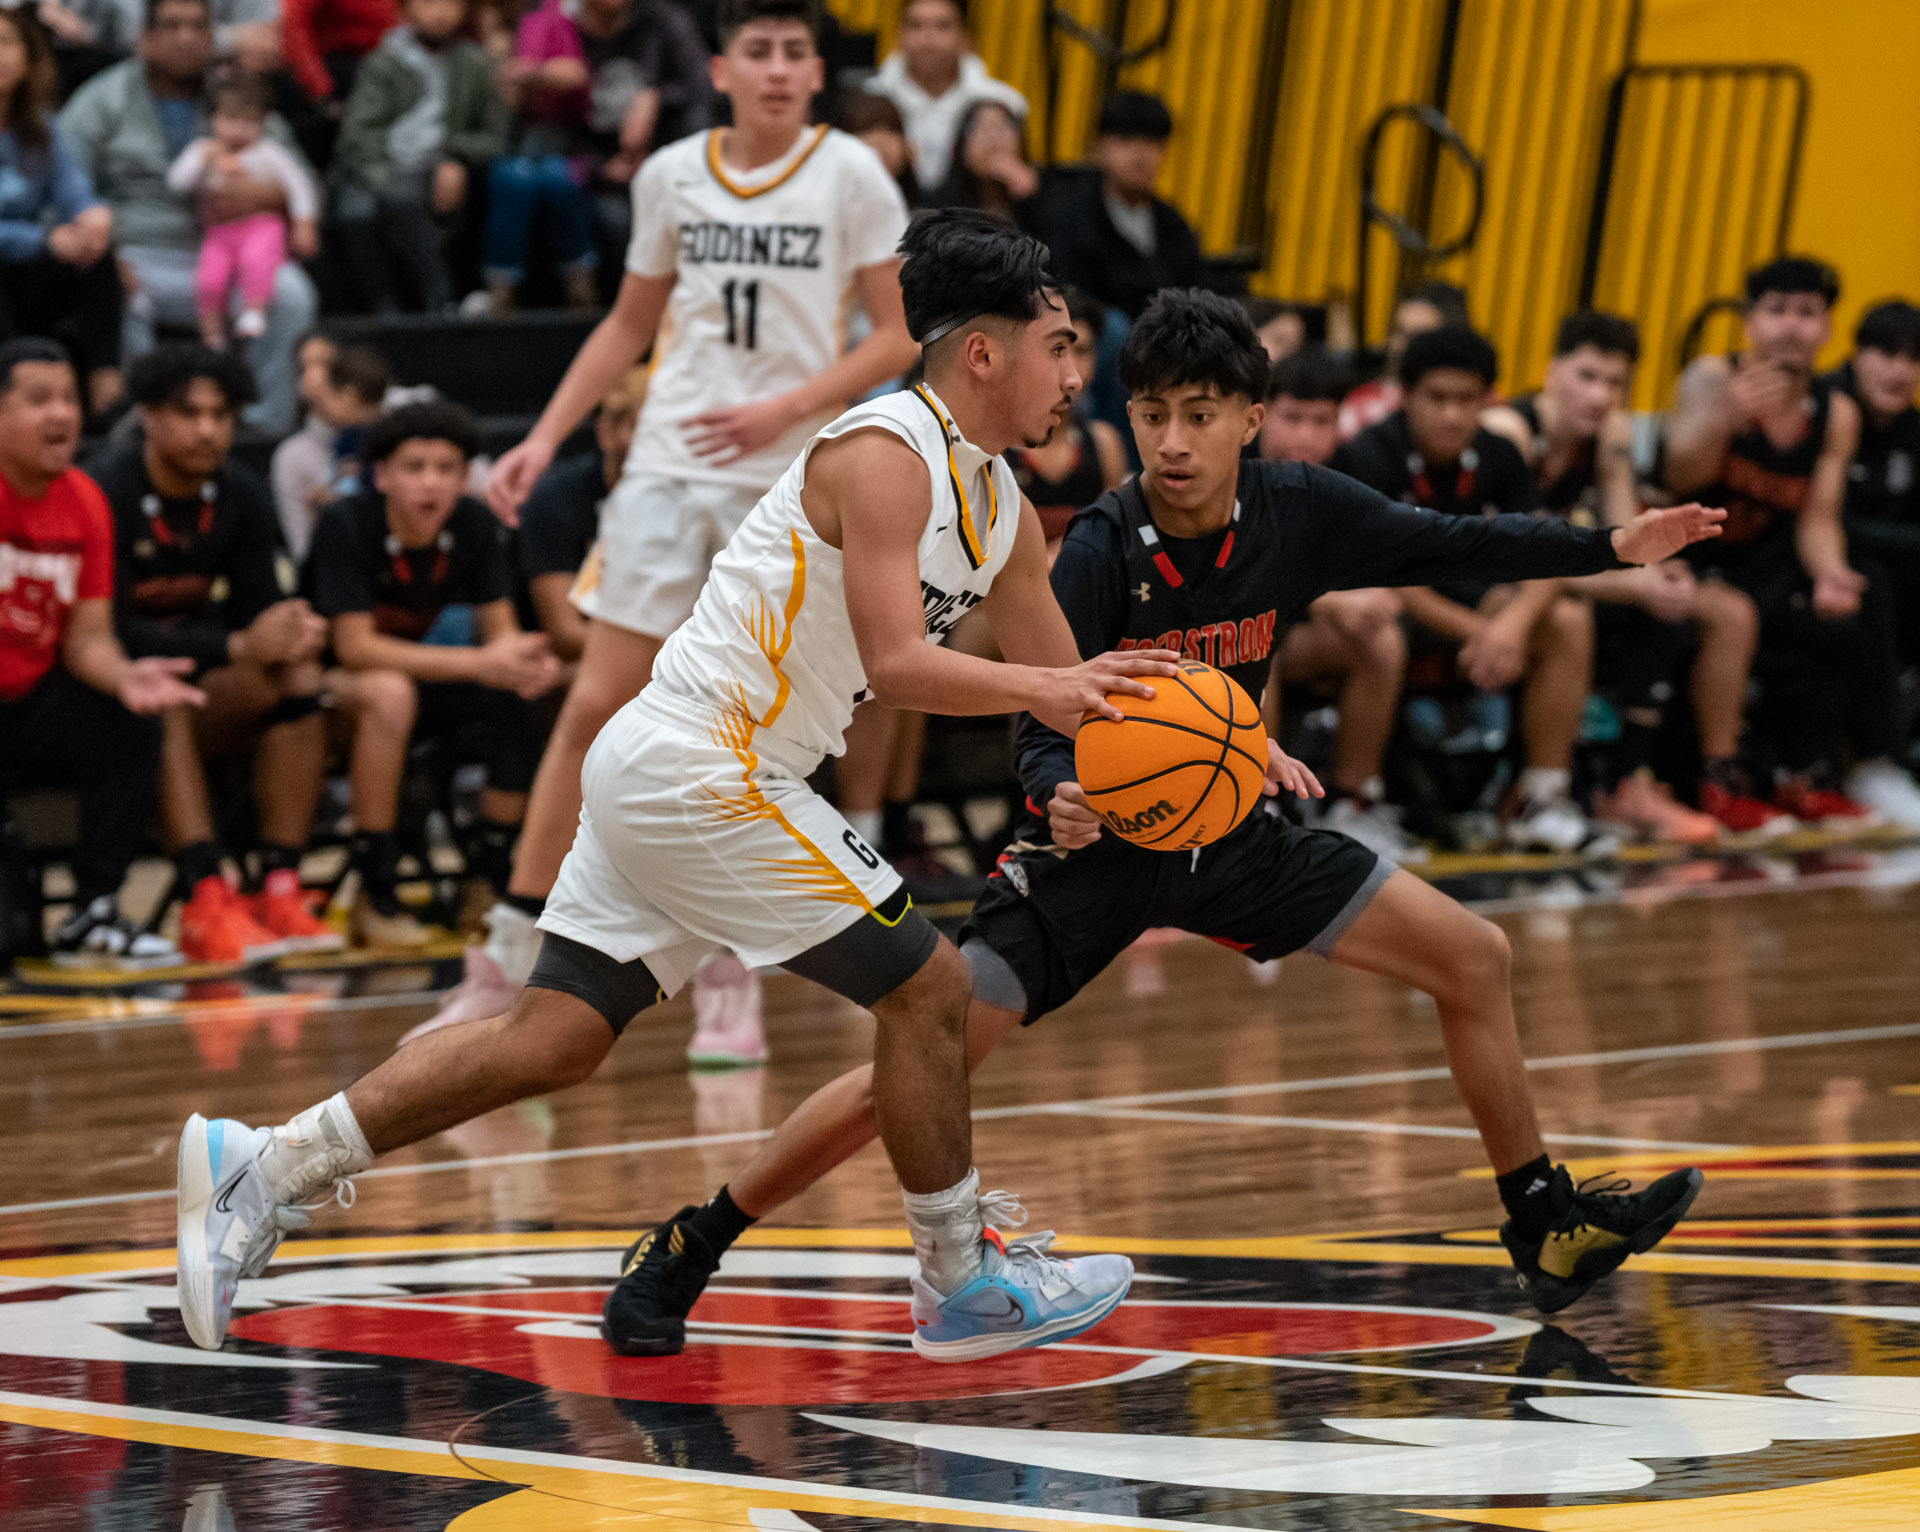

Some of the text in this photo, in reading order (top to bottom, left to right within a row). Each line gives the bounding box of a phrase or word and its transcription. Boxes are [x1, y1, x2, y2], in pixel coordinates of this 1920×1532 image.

[722, 277, 759, 351] 11
[1113, 608, 1277, 668] RSTROM
[841, 828, 880, 871] G
